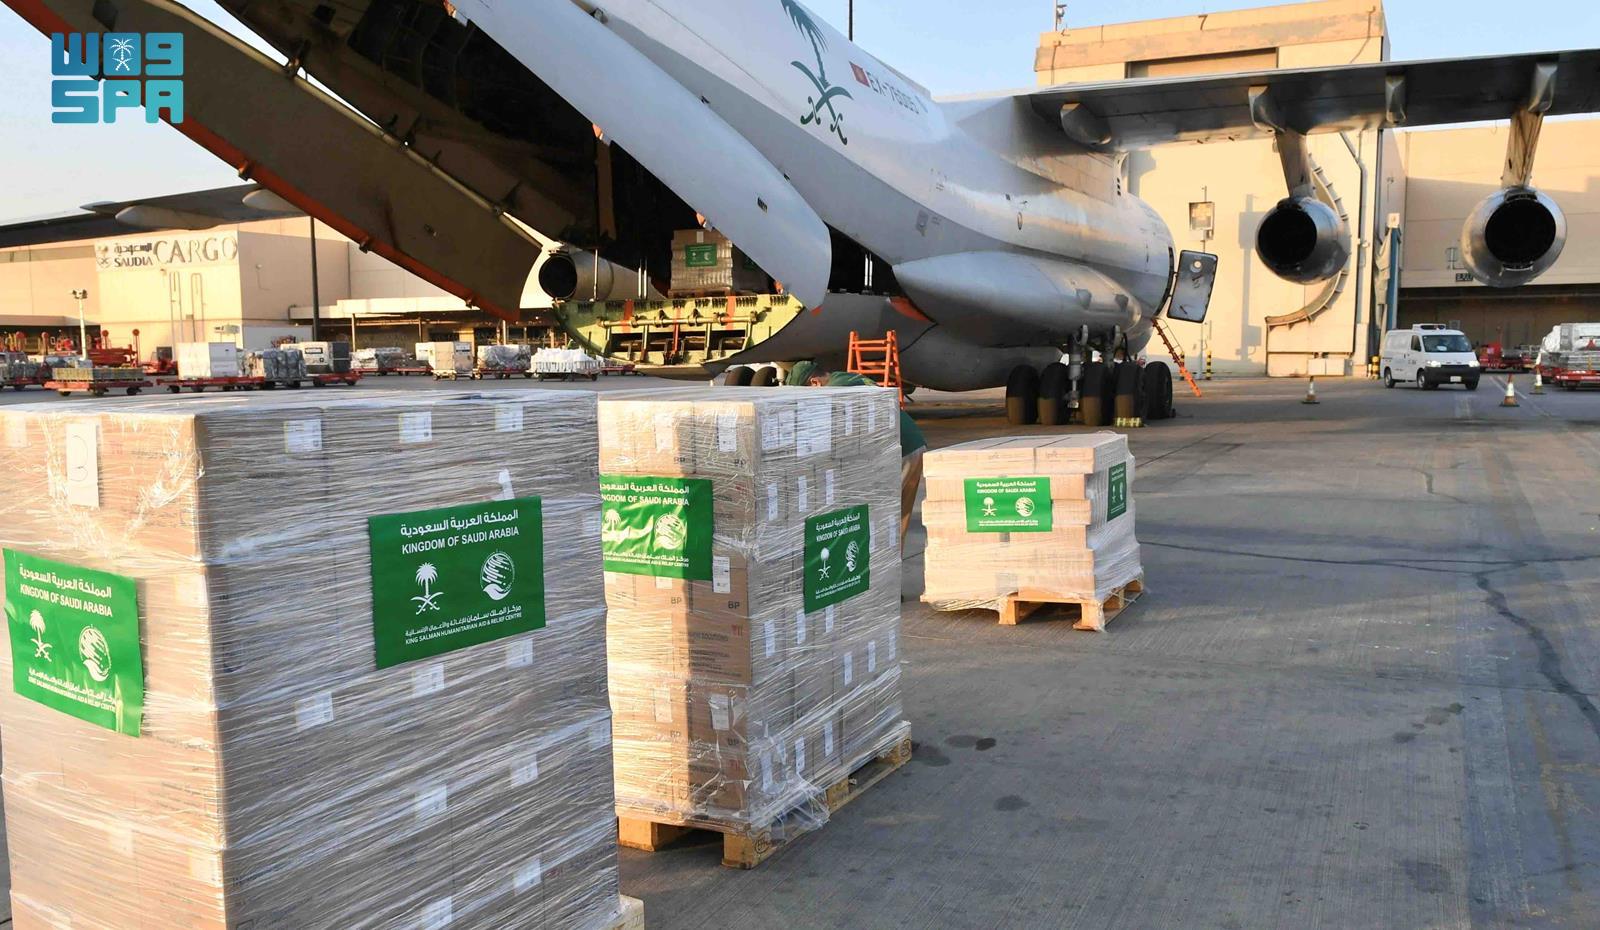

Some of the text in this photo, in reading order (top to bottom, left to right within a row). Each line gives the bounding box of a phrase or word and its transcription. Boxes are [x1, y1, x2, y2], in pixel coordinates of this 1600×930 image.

[153, 236, 238, 264] CARGO
[114, 256, 153, 268] SAUDIA
[630, 482, 657, 493] العربية
[659, 484, 690, 494] المملكة
[639, 496, 662, 504] SAUDI
[662, 497, 689, 506] ARABIA
[400, 509, 519, 538] المملكة العربية السعودية
[402, 526, 520, 554] KINGDOM OF SAUDI ARABIA
[19, 563, 112, 599] المملكة العربية السعودية
[20, 584, 113, 617] KINGDOM OF SAUDI ARABIA
[671, 597, 682, 605] BP
[728, 601, 740, 609] BP
[405, 637, 419, 645] KING
[419, 631, 441, 642] SALMAN
[440, 623, 478, 636] HUMANITARIAN
[490, 616, 505, 624] RELIEF
[504, 612, 522, 621] CENTRE
